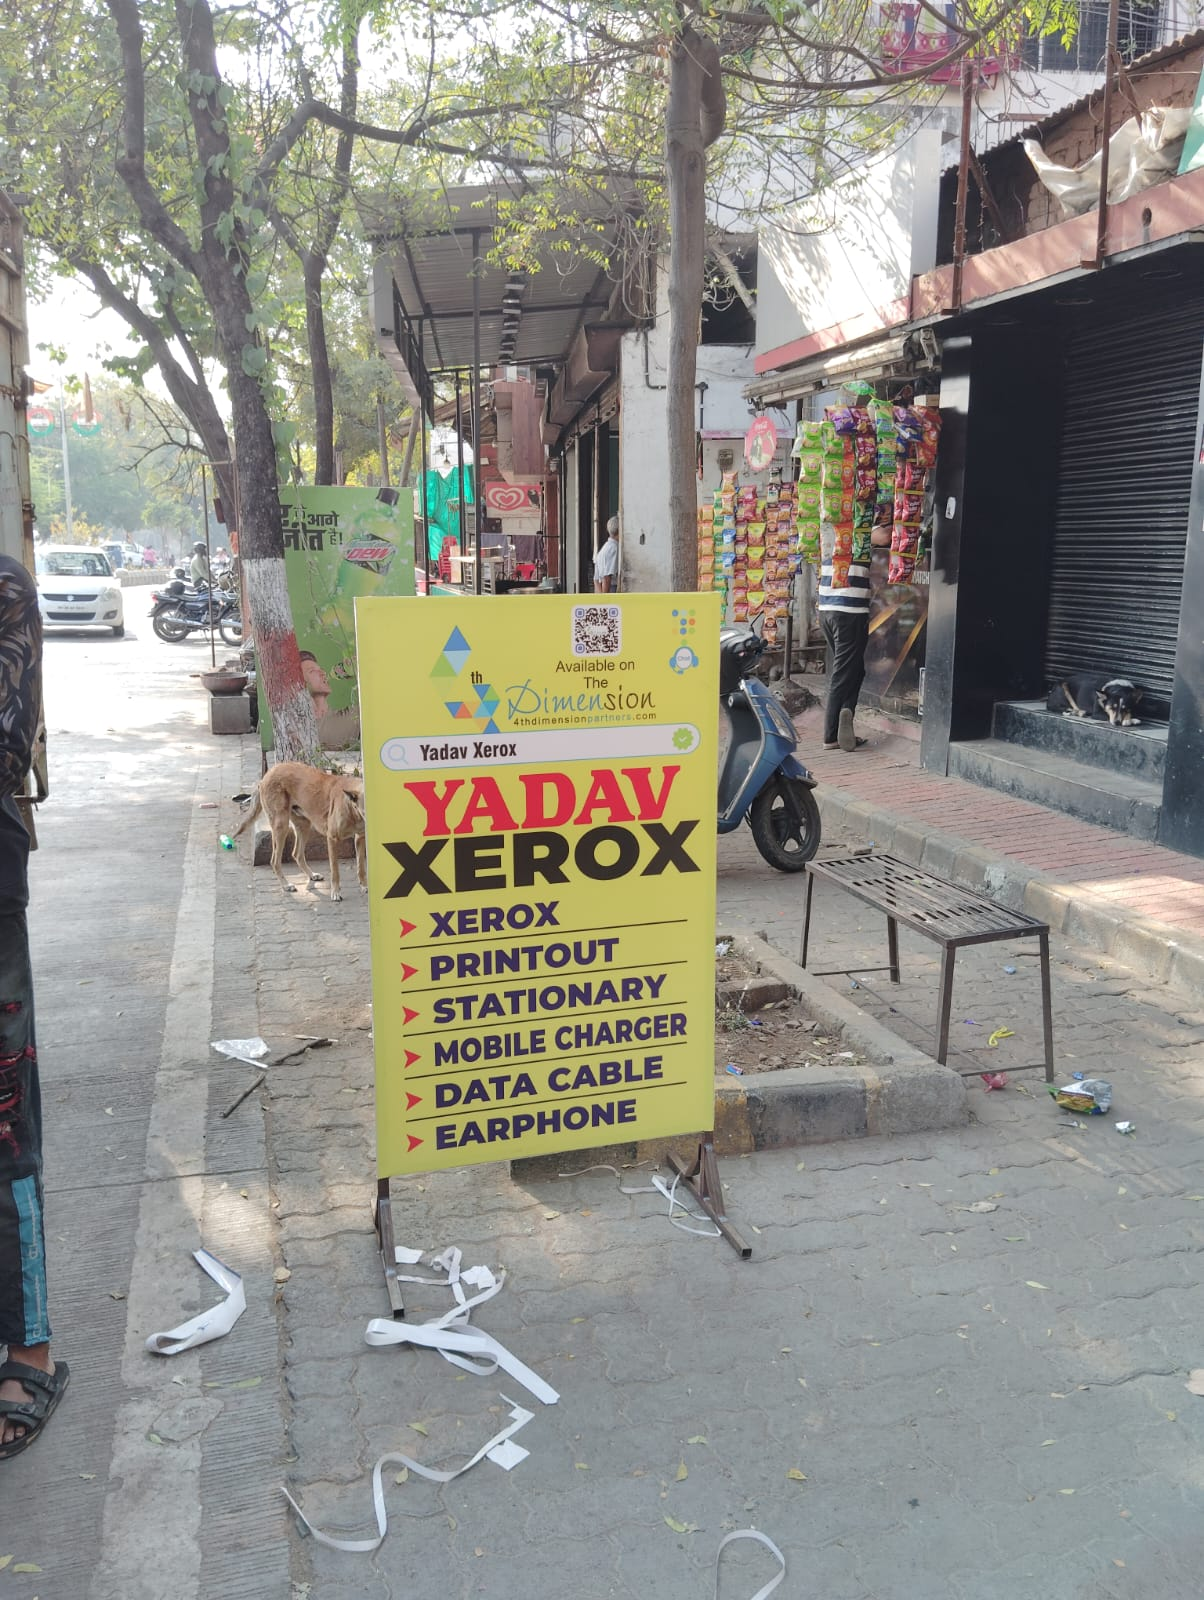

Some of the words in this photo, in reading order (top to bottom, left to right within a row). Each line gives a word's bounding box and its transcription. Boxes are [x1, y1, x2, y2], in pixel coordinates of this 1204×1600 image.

[307, 510, 340, 527] आगे
[555, 659, 615, 673] Available
[619, 660, 635, 671] on
[583, 676, 609, 689] The
[505, 678, 657, 721] Dimension
[513, 711, 657, 726] 4thdimensionpartners.com
[420, 743, 468, 761] Yadav
[473, 741, 517, 759] Xerox
[404, 765, 681, 837] YADAV
[382, 820, 701, 899] XEROX
[429, 901, 560, 938] XEROX
[430, 938, 620, 981] PRINTOUT
[433, 974, 668, 1024] STATIONARY
[434, 1029, 546, 1067] MOBILE
[555, 1013, 688, 1047] CHARGER
[435, 1073, 537, 1108] DATA
[548, 1055, 663, 1092] CABLE
[436, 1099, 637, 1151] EARPHONE
